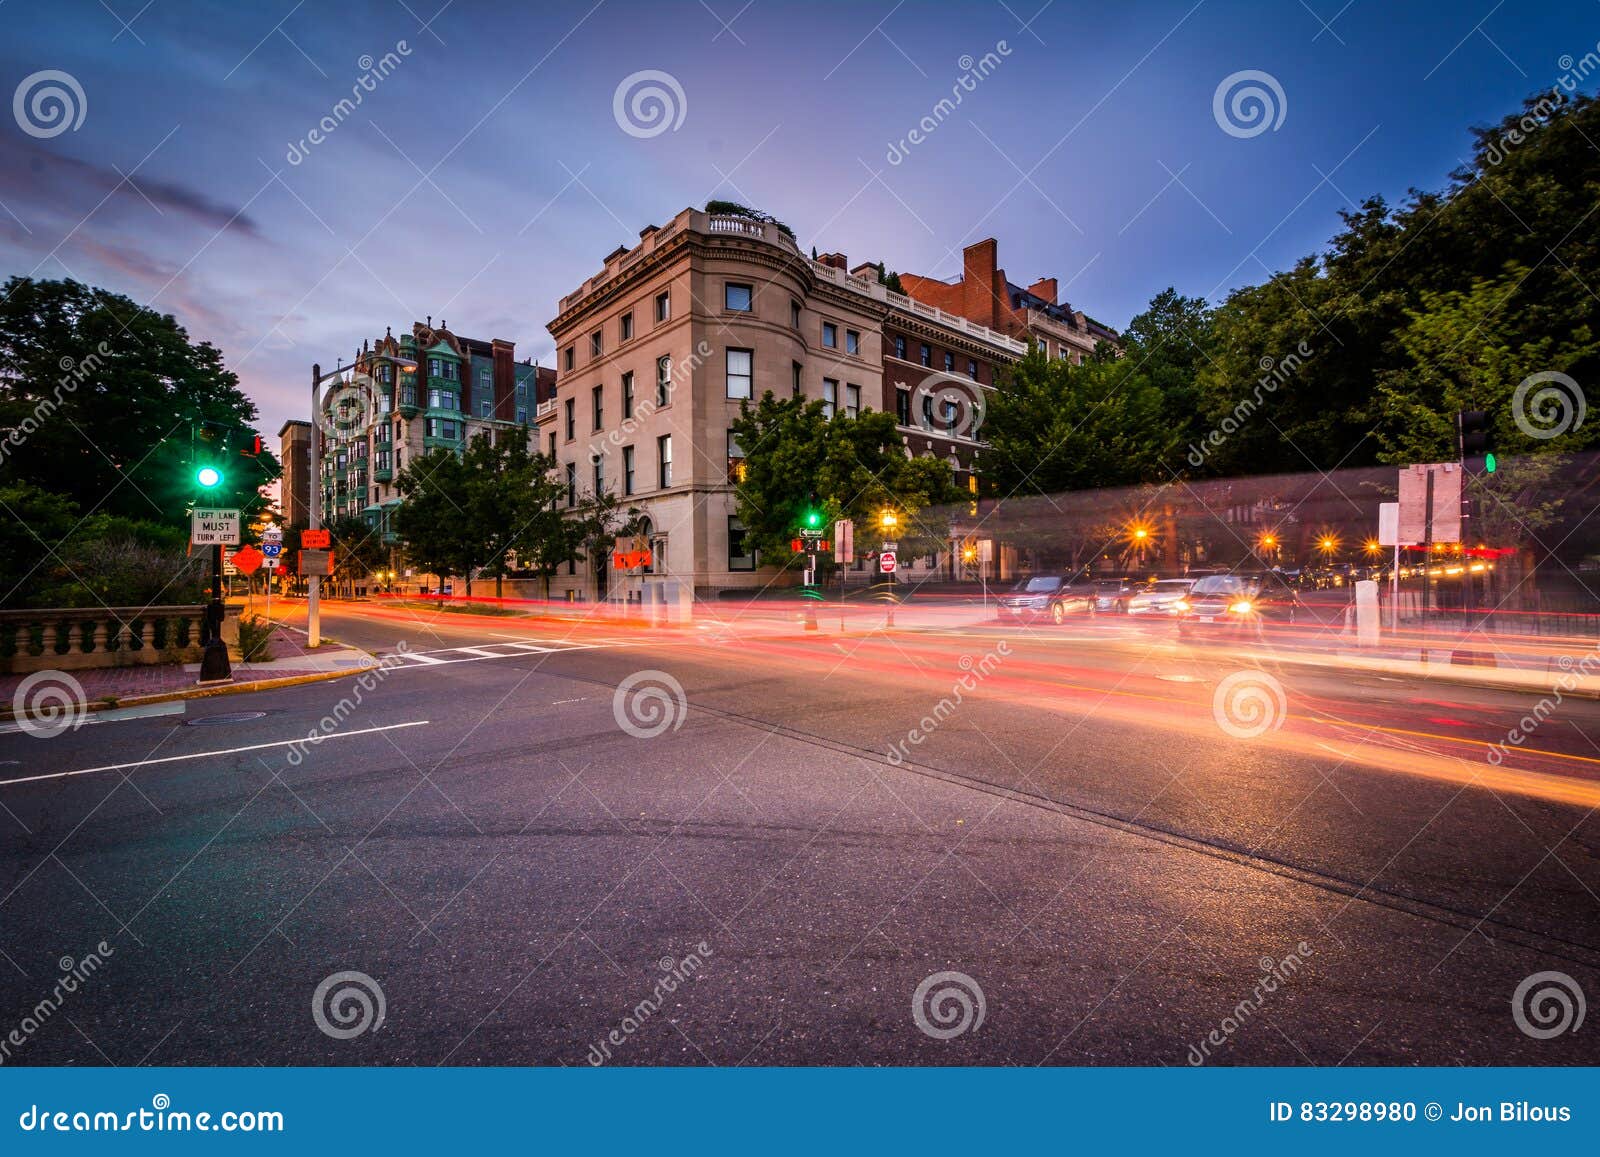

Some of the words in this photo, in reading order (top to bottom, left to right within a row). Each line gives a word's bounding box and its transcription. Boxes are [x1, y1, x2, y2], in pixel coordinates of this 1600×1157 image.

[197, 511, 214, 519] LEFT
[202, 522, 230, 531] MUST
[197, 533, 215, 541] TURN
[264, 545, 279, 554] 93
